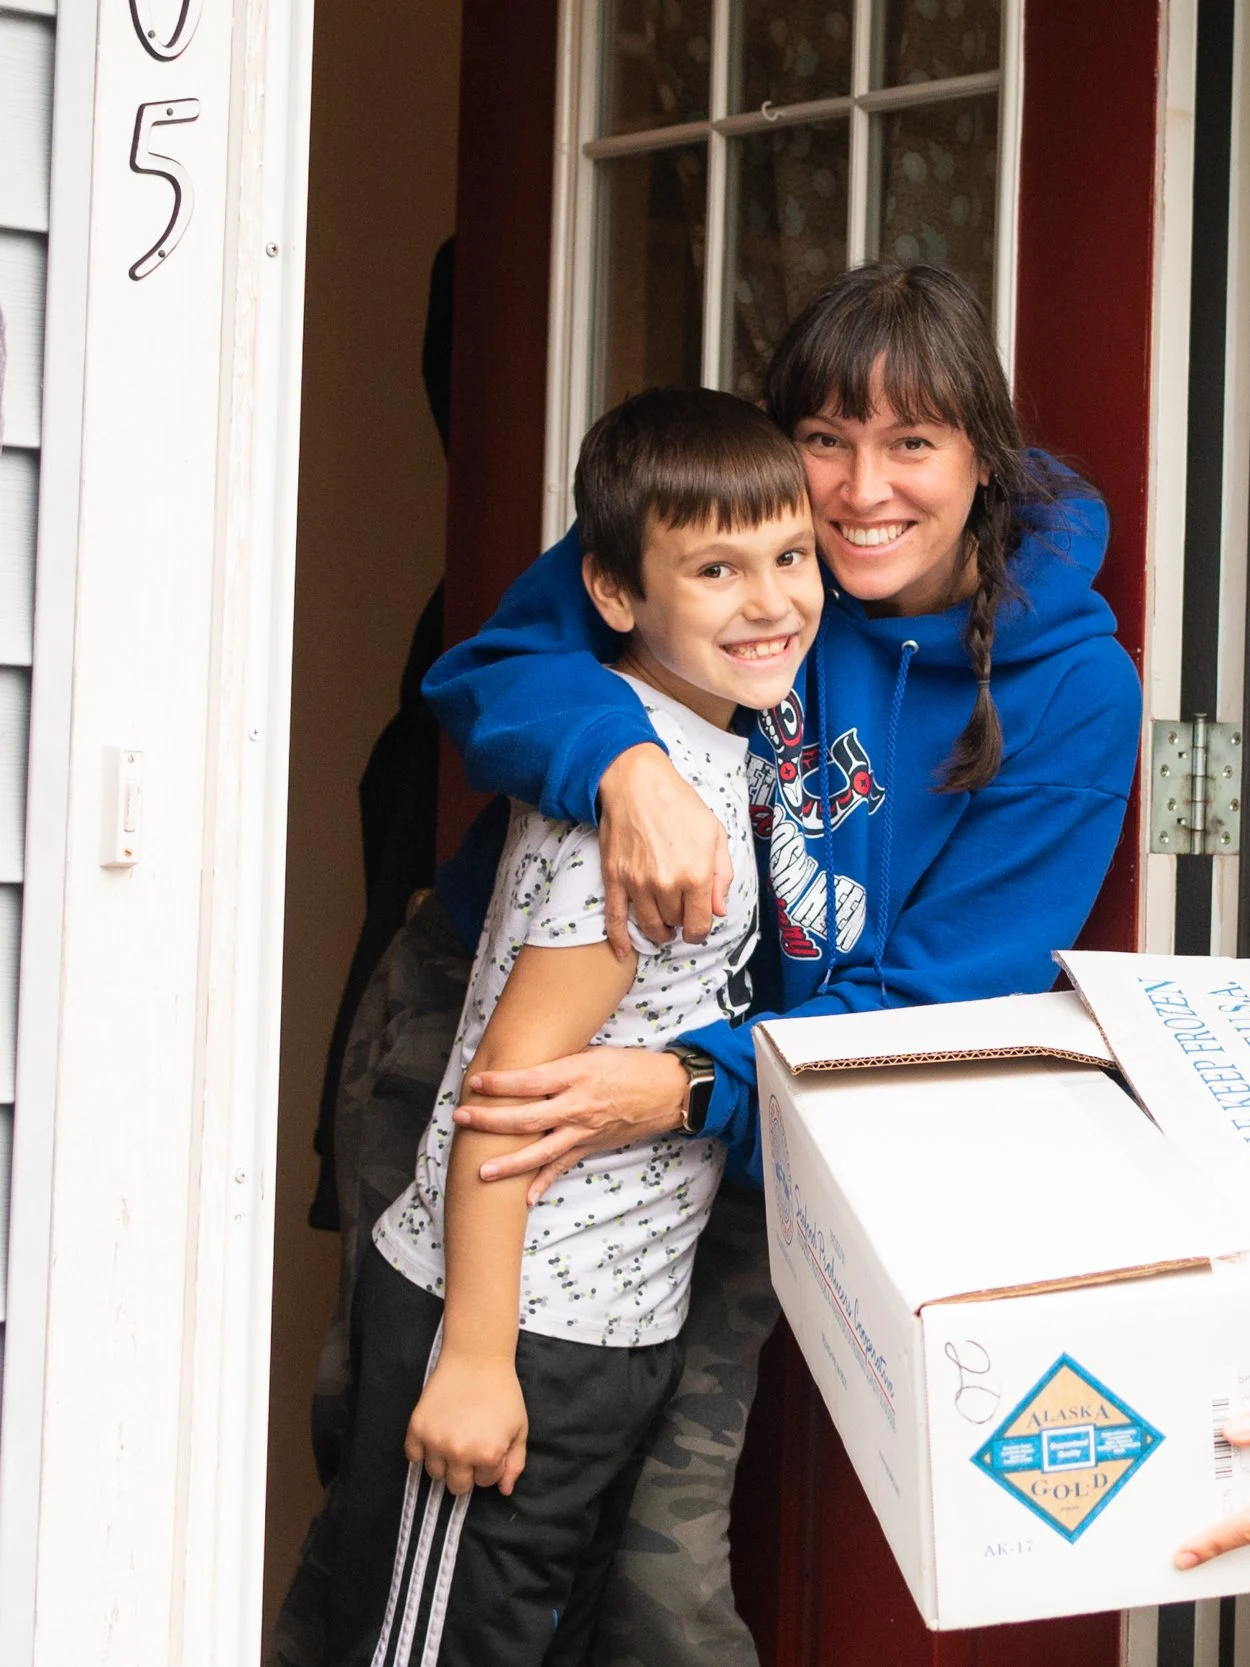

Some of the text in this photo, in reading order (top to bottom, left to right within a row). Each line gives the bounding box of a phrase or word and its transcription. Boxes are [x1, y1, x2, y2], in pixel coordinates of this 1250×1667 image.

[1137, 976, 1226, 1056] FROZEN
[1026, 1403, 1110, 1429] ALASKA
[1031, 1472, 1108, 1500] GOLD
[983, 1540, 1034, 1558] AK-17
